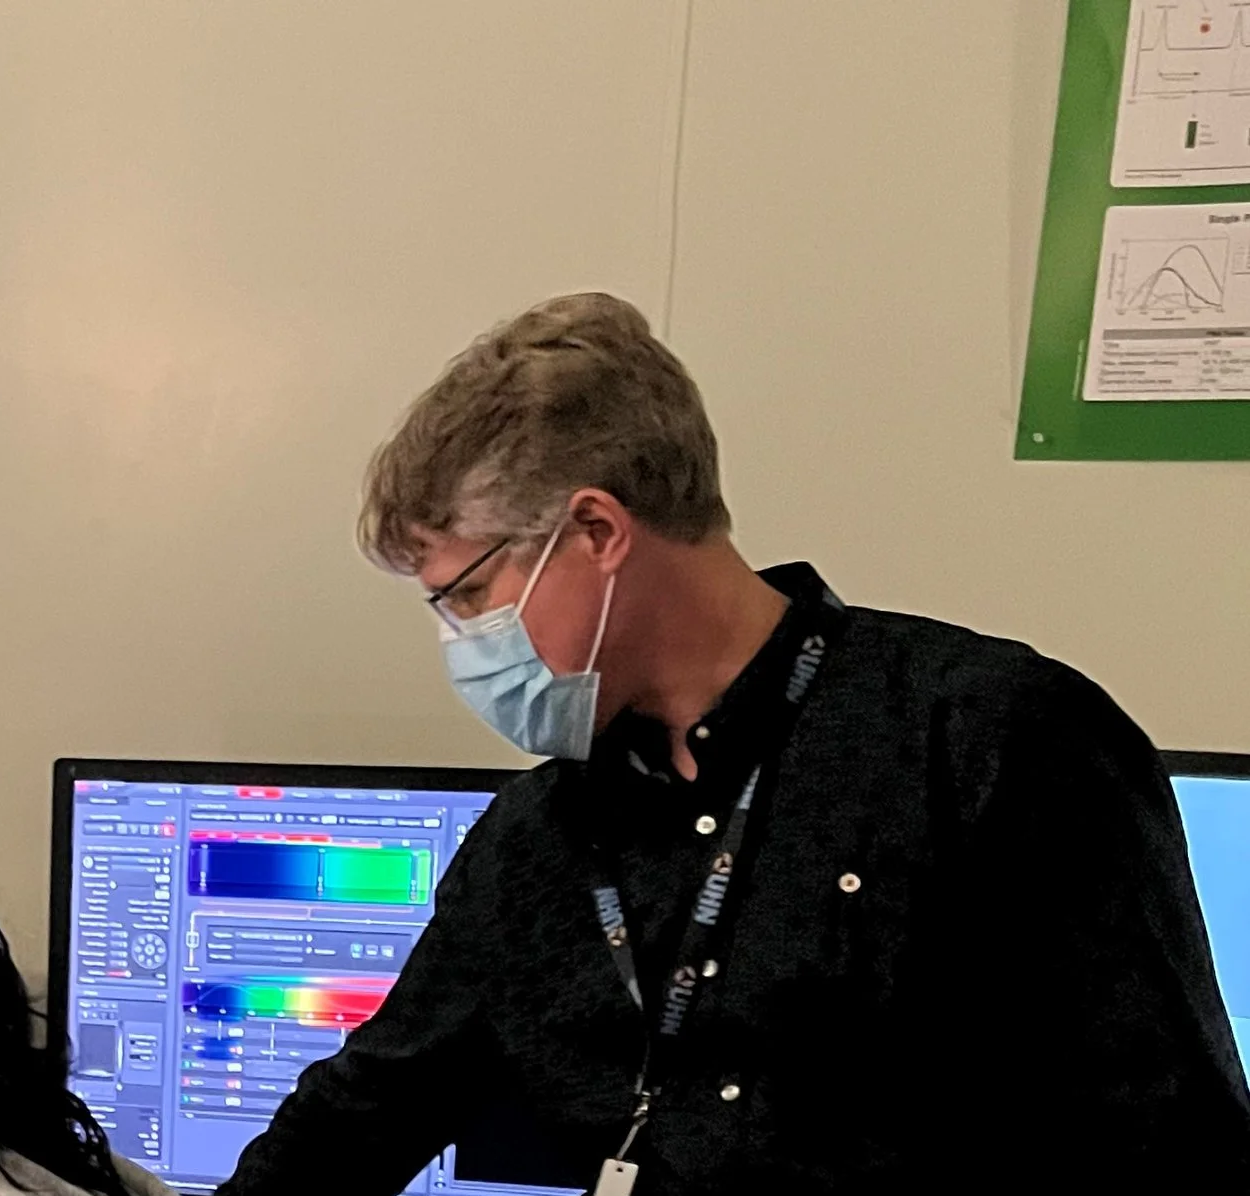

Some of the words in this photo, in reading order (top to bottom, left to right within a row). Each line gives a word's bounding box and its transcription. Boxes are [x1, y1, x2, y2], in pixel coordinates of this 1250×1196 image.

[786, 653, 821, 704] UHN
[591, 887, 625, 931] UHN
[694, 873, 730, 926] UHN
[659, 984, 695, 1036] UHN
